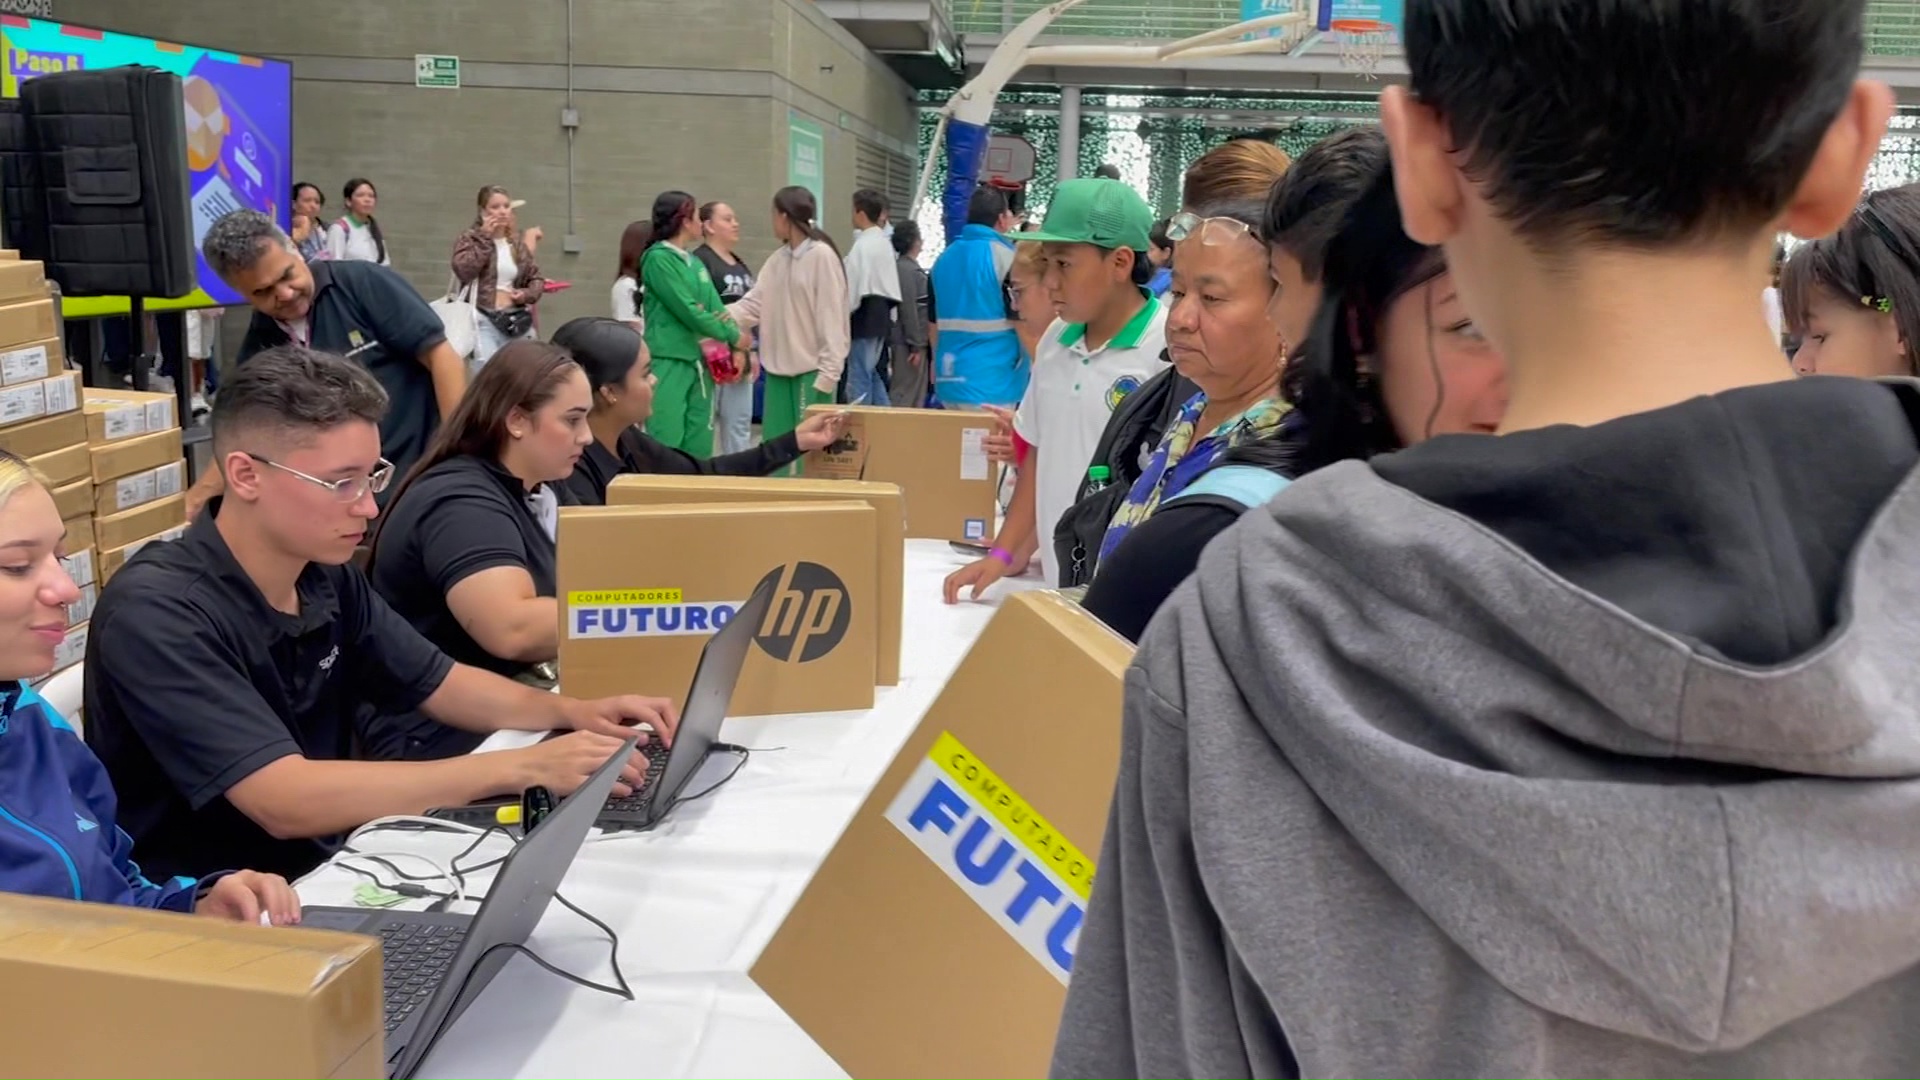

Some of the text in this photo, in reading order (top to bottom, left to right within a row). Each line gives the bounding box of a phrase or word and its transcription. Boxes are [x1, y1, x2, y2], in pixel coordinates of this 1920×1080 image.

[577, 591, 680, 603] COMPUTADORES
[756, 561, 846, 662] hp
[576, 604, 736, 634] FUTURO
